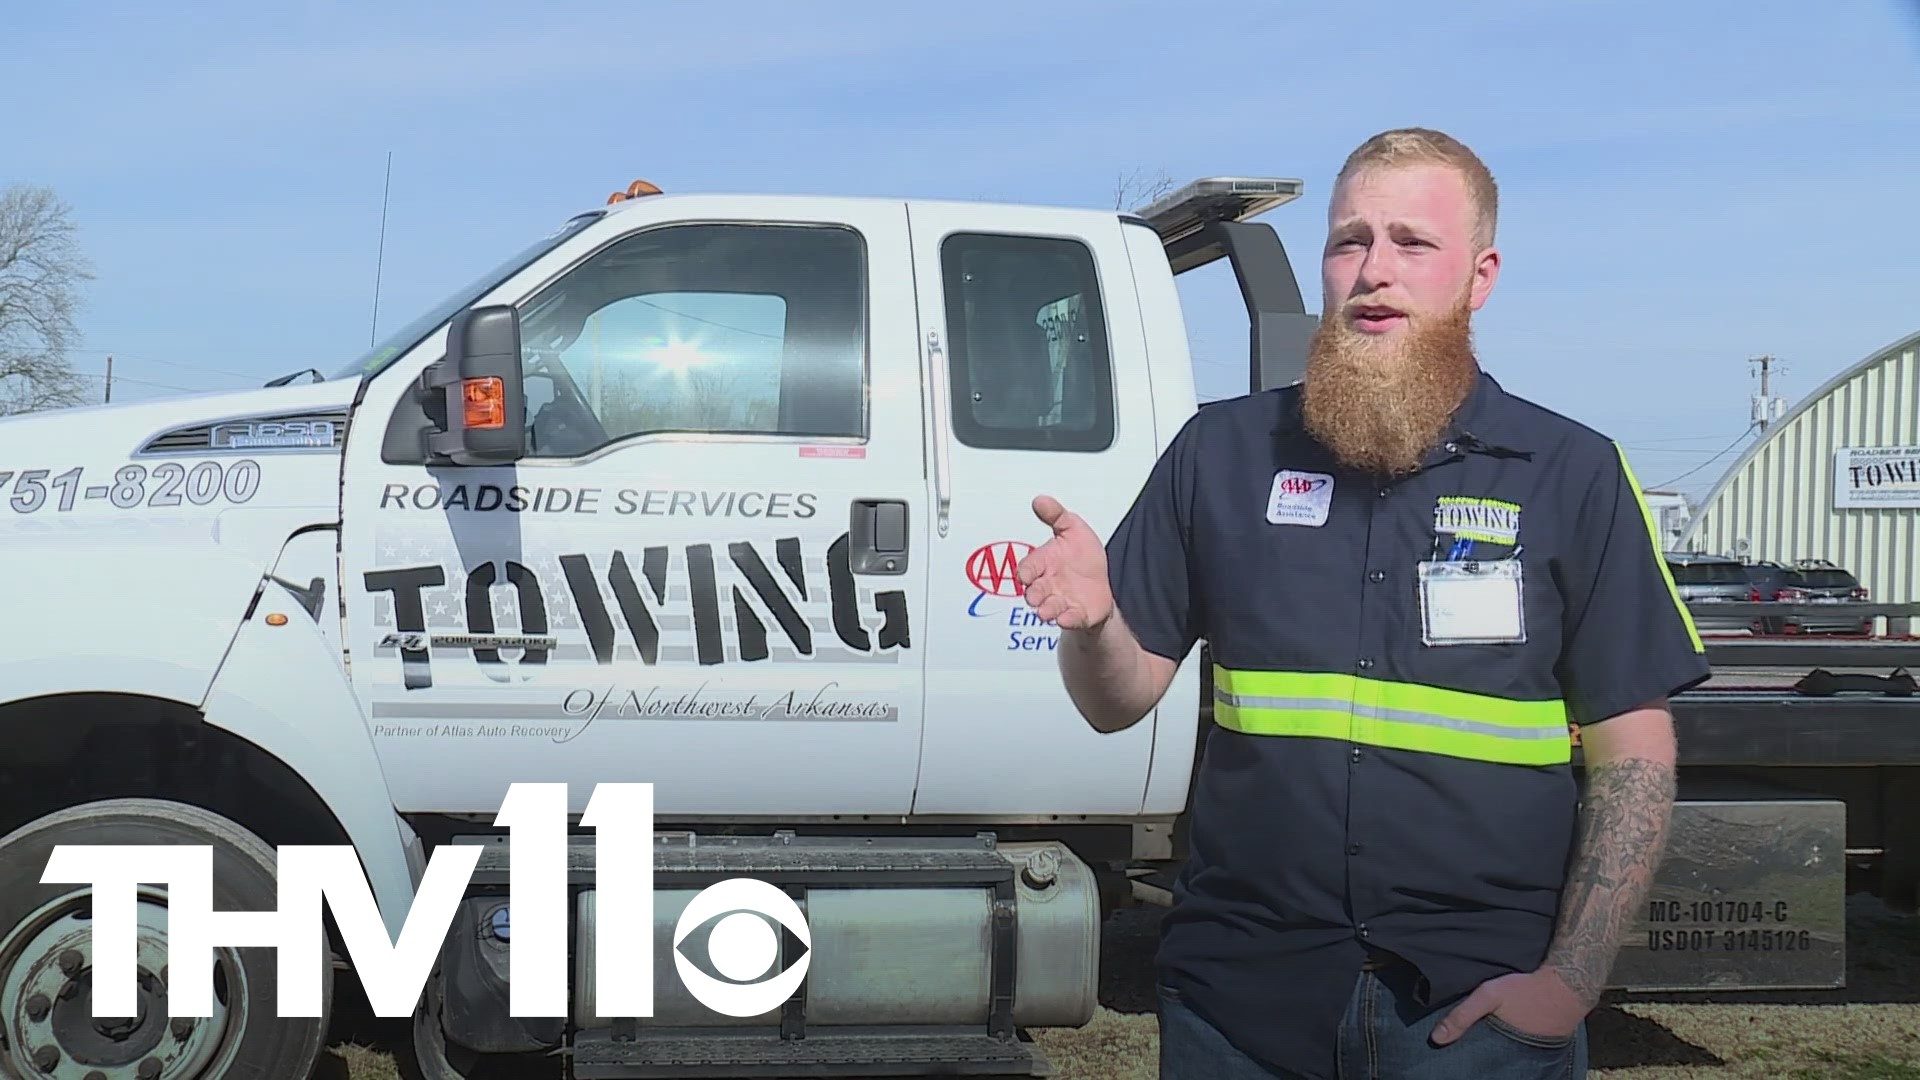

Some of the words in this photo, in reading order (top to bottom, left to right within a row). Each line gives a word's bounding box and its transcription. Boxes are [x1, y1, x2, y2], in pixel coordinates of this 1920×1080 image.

[1849, 460, 1920, 488] TOWI
[379, 482, 602, 514] ROADSIDE
[614, 488, 818, 519] SERVICES
[1434, 506, 1519, 532] TOWING
[363, 530, 912, 690] TOWING
[433, 636, 488, 646] POWER
[492, 636, 553, 647] STROKE
[555, 684, 616, 743] Of
[618, 681, 757, 717] Northwest
[761, 682, 889, 719] Arkansas
[374, 725, 423, 737] Partner
[425, 725, 440, 737] of
[441, 725, 474, 737] Atlas
[477, 725, 507, 737] Auto
[510, 725, 571, 739] Recovery
[1649, 901, 1788, 922] MC-101704-C
[1649, 930, 1716, 951] USDOT
[1724, 930, 1810, 951] 3145126
